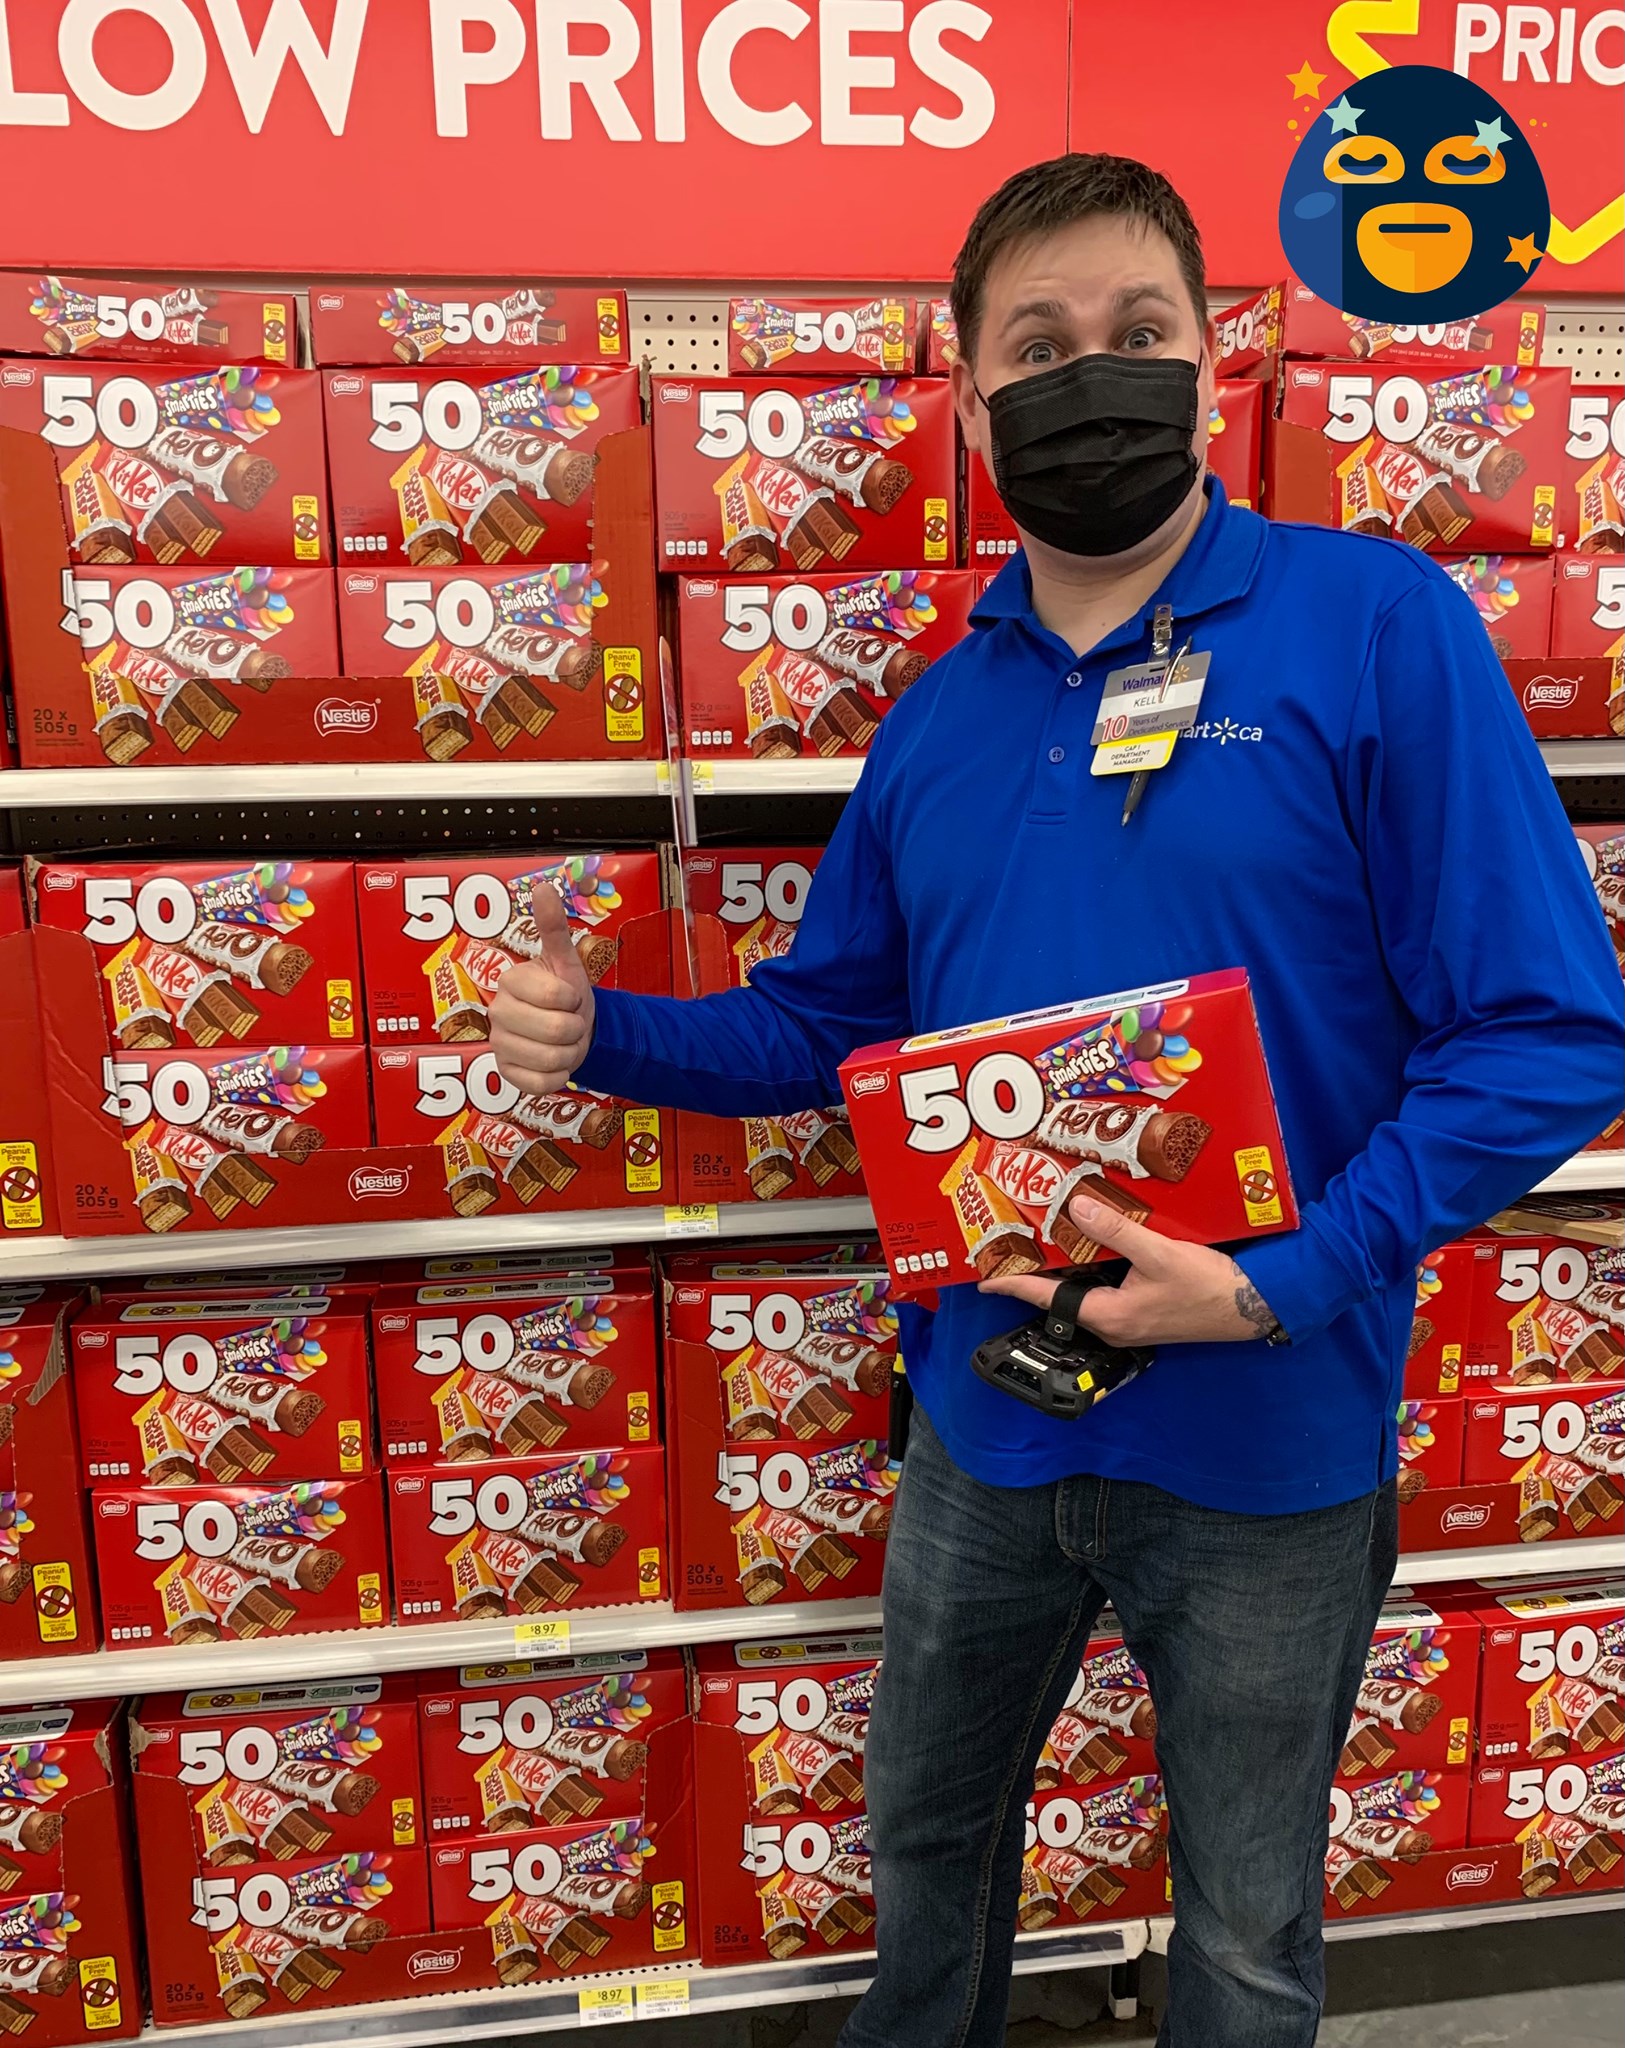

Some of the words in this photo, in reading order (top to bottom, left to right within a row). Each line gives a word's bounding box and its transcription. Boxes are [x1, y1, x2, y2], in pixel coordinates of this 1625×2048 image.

[0, 0, 368, 136] LOW
[430, 0, 996, 149] PRICES
[95, 296, 166, 342] 50
[441, 303, 508, 345] 50
[791, 312, 857, 354] 50
[1222, 310, 1254, 358] 50
[41, 376, 159, 448] 50
[369, 380, 482, 452] 50
[695, 390, 805, 458] 50
[1322, 376, 1430, 443] 50
[110, 458, 156, 504] KitKat
[431, 460, 482, 503] KitKat
[757, 466, 802, 512] KitKat
[1376, 455, 1422, 497] KitKat
[60, 570, 174, 648] 50
[383, 579, 494, 648] 50
[721, 585, 828, 652] 50
[778, 660, 824, 703] KitKat
[1122, 675, 1165, 691] Walmar
[1133, 696, 1161, 708] KELL
[33, 708, 52, 721] 20
[59, 712, 68, 720] x
[34, 721, 63, 734] 505
[67, 723, 77, 736] g
[1102, 715, 1129, 742] 10
[1128, 725, 1164, 737] Dedicated
[1165, 720, 1190, 731] Service
[1132, 717, 1150, 725] Years
[1151, 715, 1160, 723] of
[1179, 722, 1210, 738] art
[1111, 750, 1150, 760] DEPARTMENT
[1113, 758, 1143, 766] MANAGER
[82, 878, 196, 944] 50
[402, 873, 511, 942] 50
[717, 862, 813, 923] 50
[149, 951, 195, 995] KitKat
[465, 949, 502, 988] KitKa
[101, 1057, 210, 1126] 50
[415, 1052, 521, 1116] 50
[898, 1052, 1046, 1154] 50
[995, 1151, 1058, 1201] KitKat
[1238, 1151, 1266, 1161] Peanut
[75, 1185, 93, 1196] 20
[100, 1187, 109, 1195] x
[75, 1196, 104, 1207] 505
[108, 1197, 118, 1209] g
[1496, 1247, 1589, 1302] 50
[412, 1314, 515, 1376] 50
[706, 1293, 804, 1351] 50
[113, 1333, 218, 1395] 50
[761, 1359, 802, 1395] KitKat
[470, 1377, 514, 1412] KitKat
[174, 1402, 221, 1438] KitKat
[1499, 1401, 1586, 1458] 50
[714, 1451, 810, 1512] 50
[428, 1475, 529, 1536] 50
[134, 1501, 238, 1560] 50
[484, 1538, 526, 1572] KitKat
[196, 1567, 240, 1599] KitKat
[1515, 1625, 1598, 1682] 50
[457, 1695, 553, 1754] 50
[733, 1678, 828, 1735] 50
[178, 1726, 279, 1785] 50
[512, 1756, 553, 1789] KitKat
[785, 1738, 824, 1772] KitKat
[235, 1788, 277, 1821] KitKat
[1504, 1764, 1588, 1820] 50
[740, 1821, 833, 1878] 50
[468, 1843, 563, 1903] 50
[191, 1873, 291, 1931] 50
[165, 1983, 184, 1993] 20
[166, 1991, 192, 2003] 505
